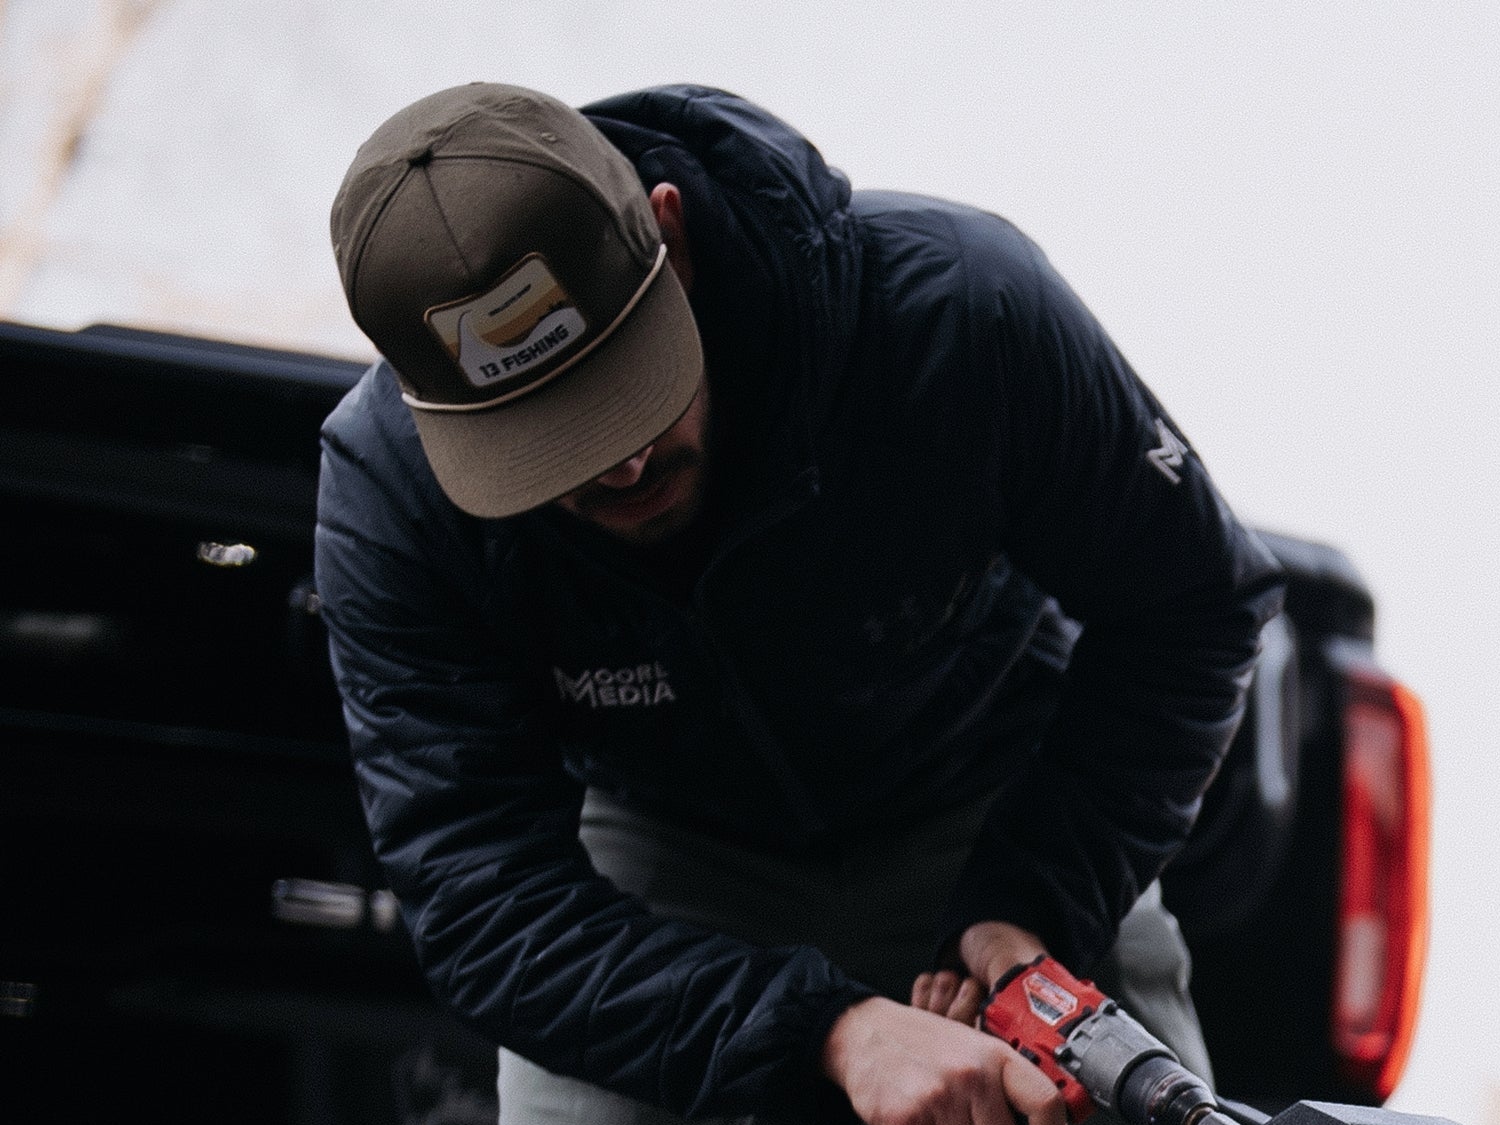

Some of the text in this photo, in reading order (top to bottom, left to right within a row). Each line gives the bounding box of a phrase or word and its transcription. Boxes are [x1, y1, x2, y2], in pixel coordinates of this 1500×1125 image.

[480, 324, 570, 378] 13 FISHING
[559, 680, 676, 707] MEDIA
